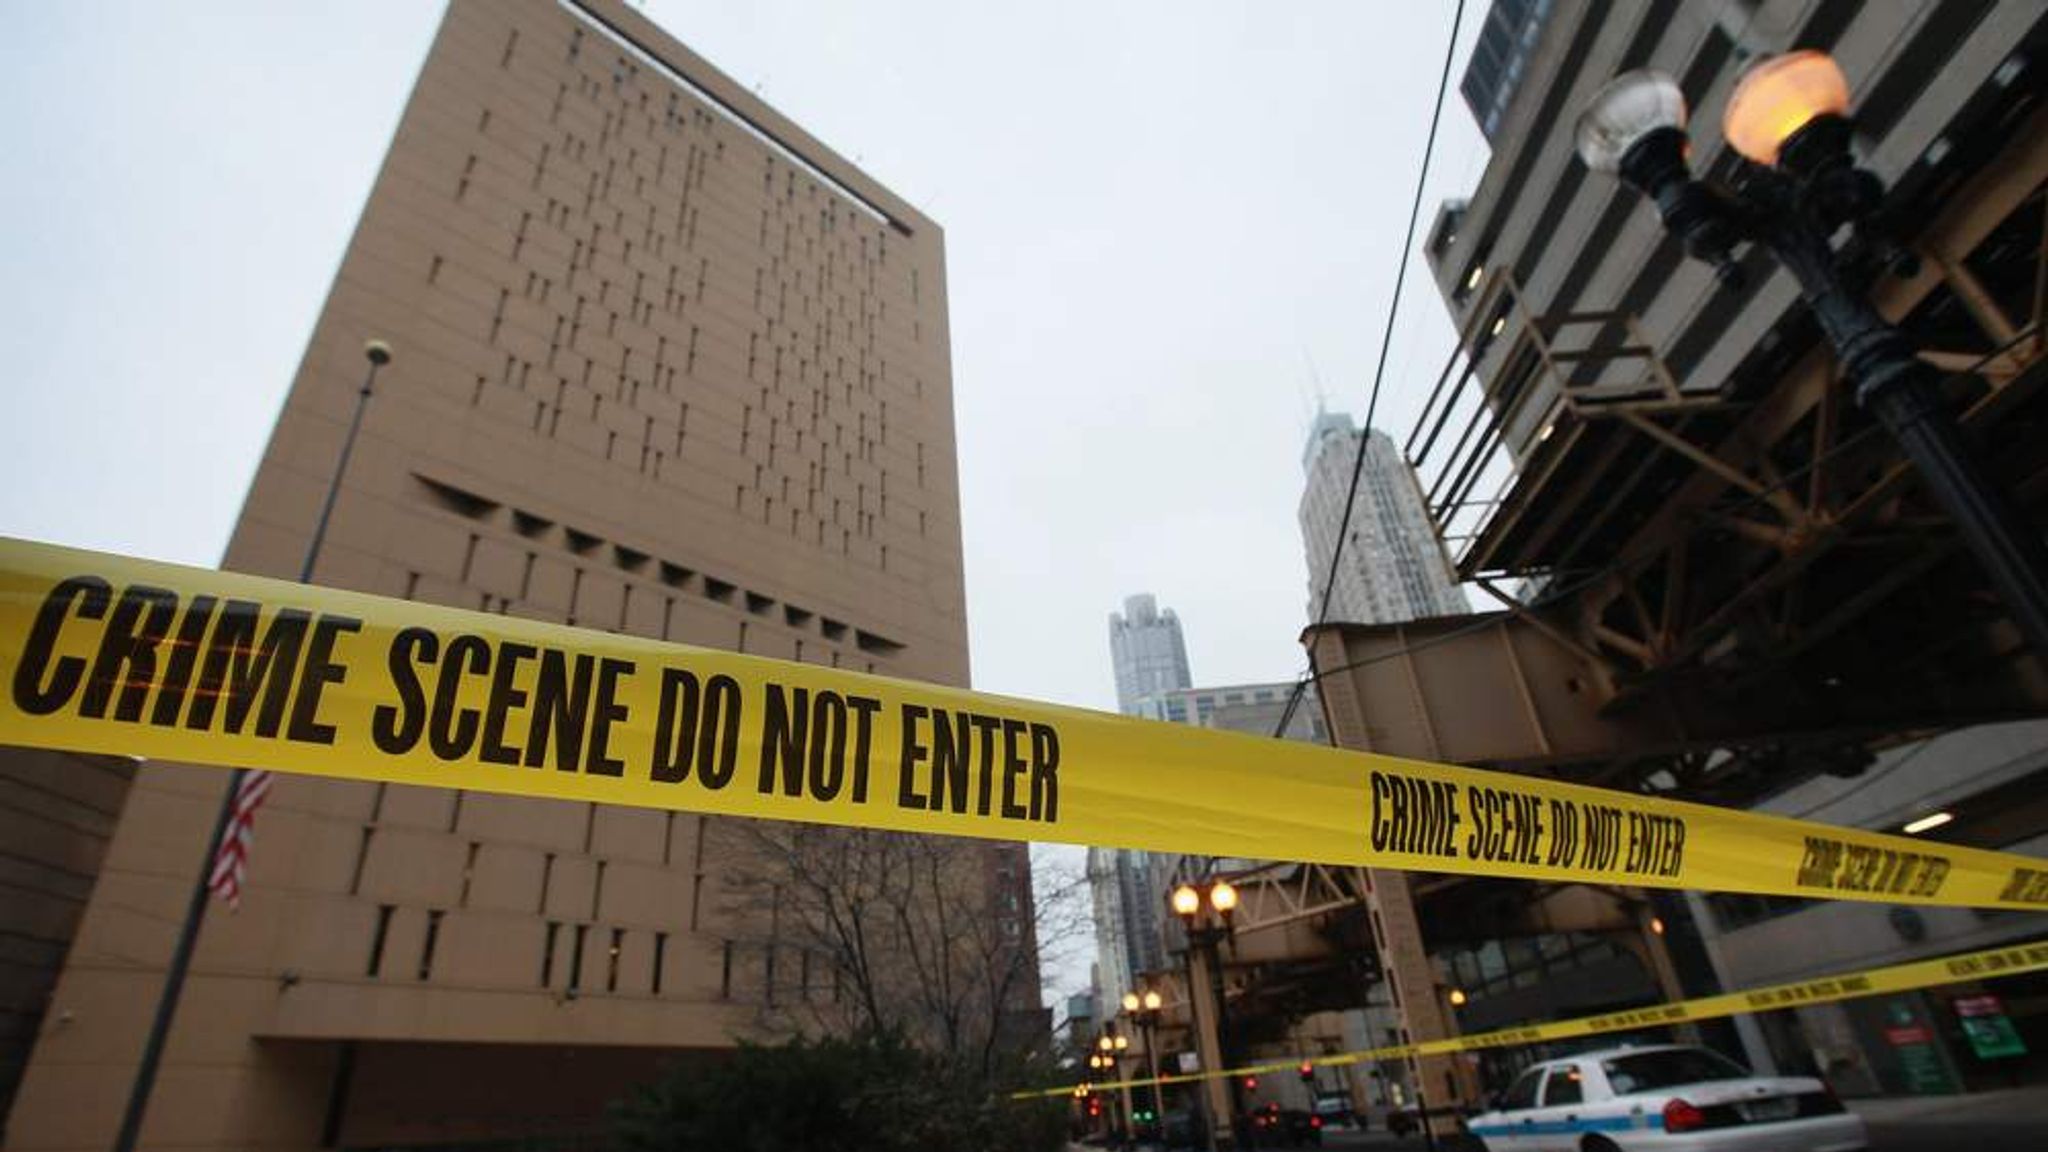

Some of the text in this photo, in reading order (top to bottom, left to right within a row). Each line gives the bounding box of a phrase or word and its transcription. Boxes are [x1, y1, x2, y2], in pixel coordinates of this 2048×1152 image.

[11, 575, 1061, 823] CRIME SCENE DO NOT ENTER
[1370, 770, 1687, 878] CRIME SCENE DO NOT ENTER
